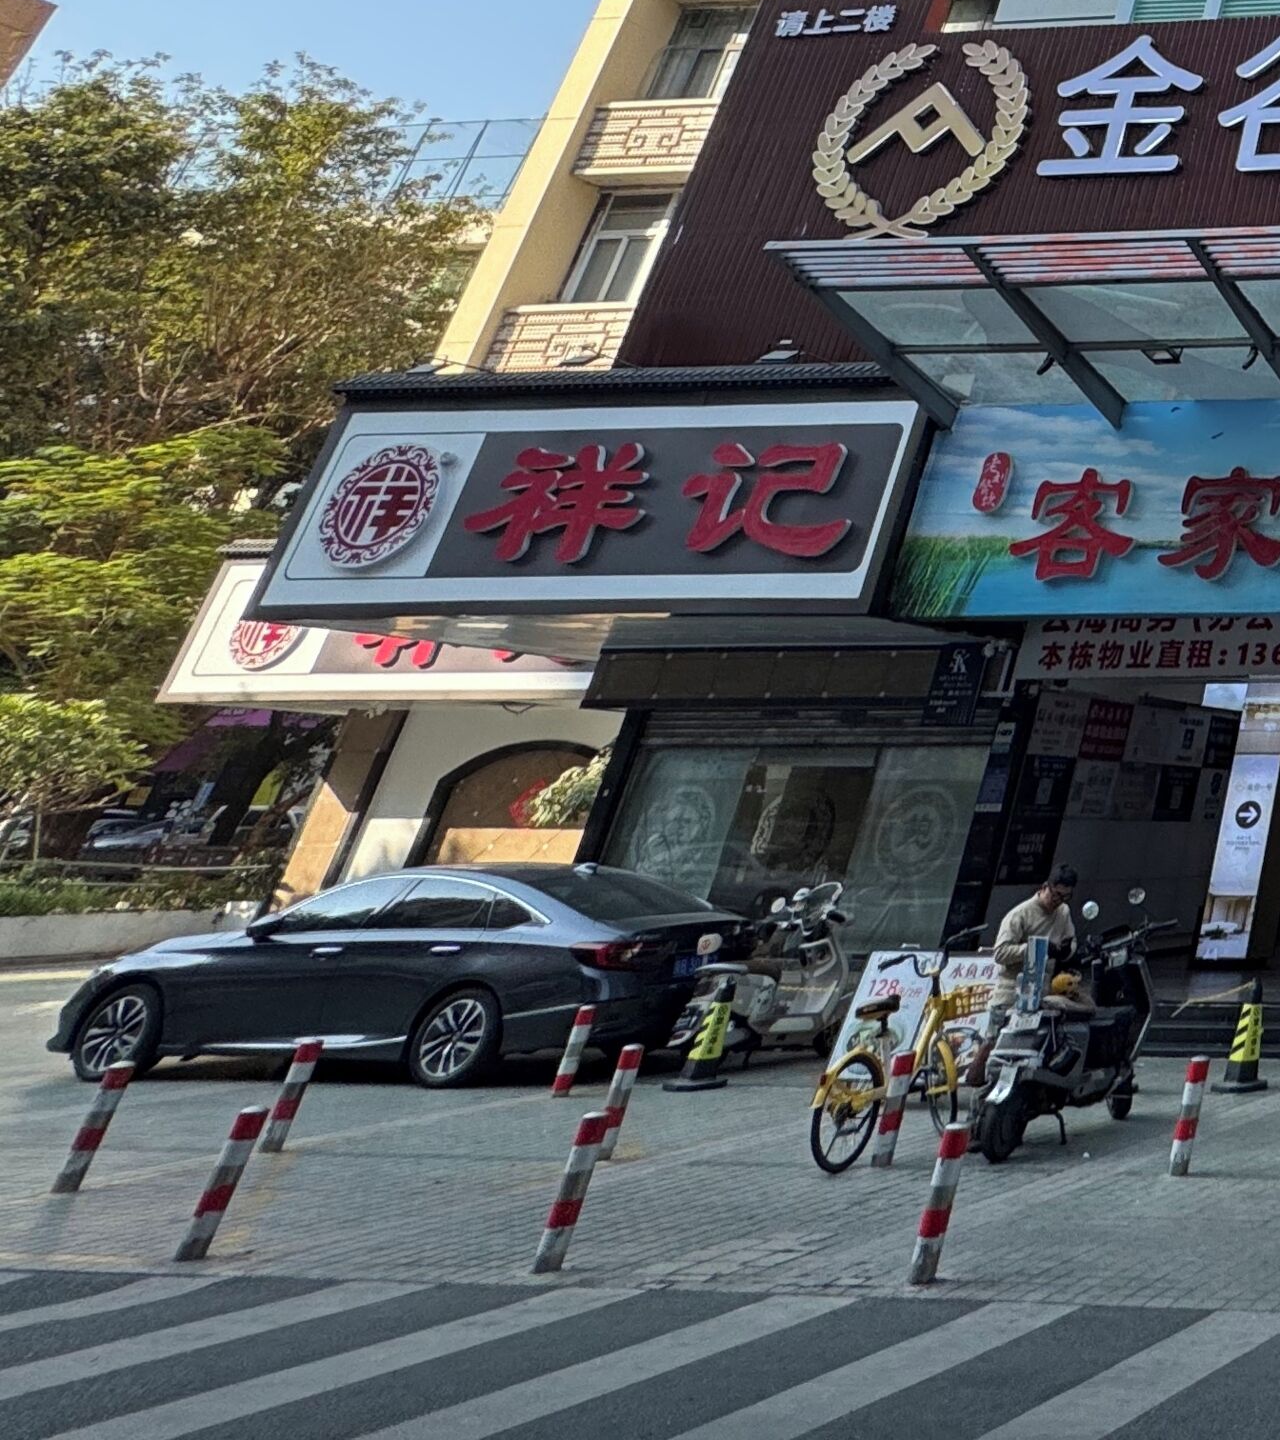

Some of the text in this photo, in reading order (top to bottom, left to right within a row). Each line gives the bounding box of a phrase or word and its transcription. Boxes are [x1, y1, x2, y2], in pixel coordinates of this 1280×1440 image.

[774, 3, 896, 38] 请上二楼
[463, 442, 855, 564] 祥记
